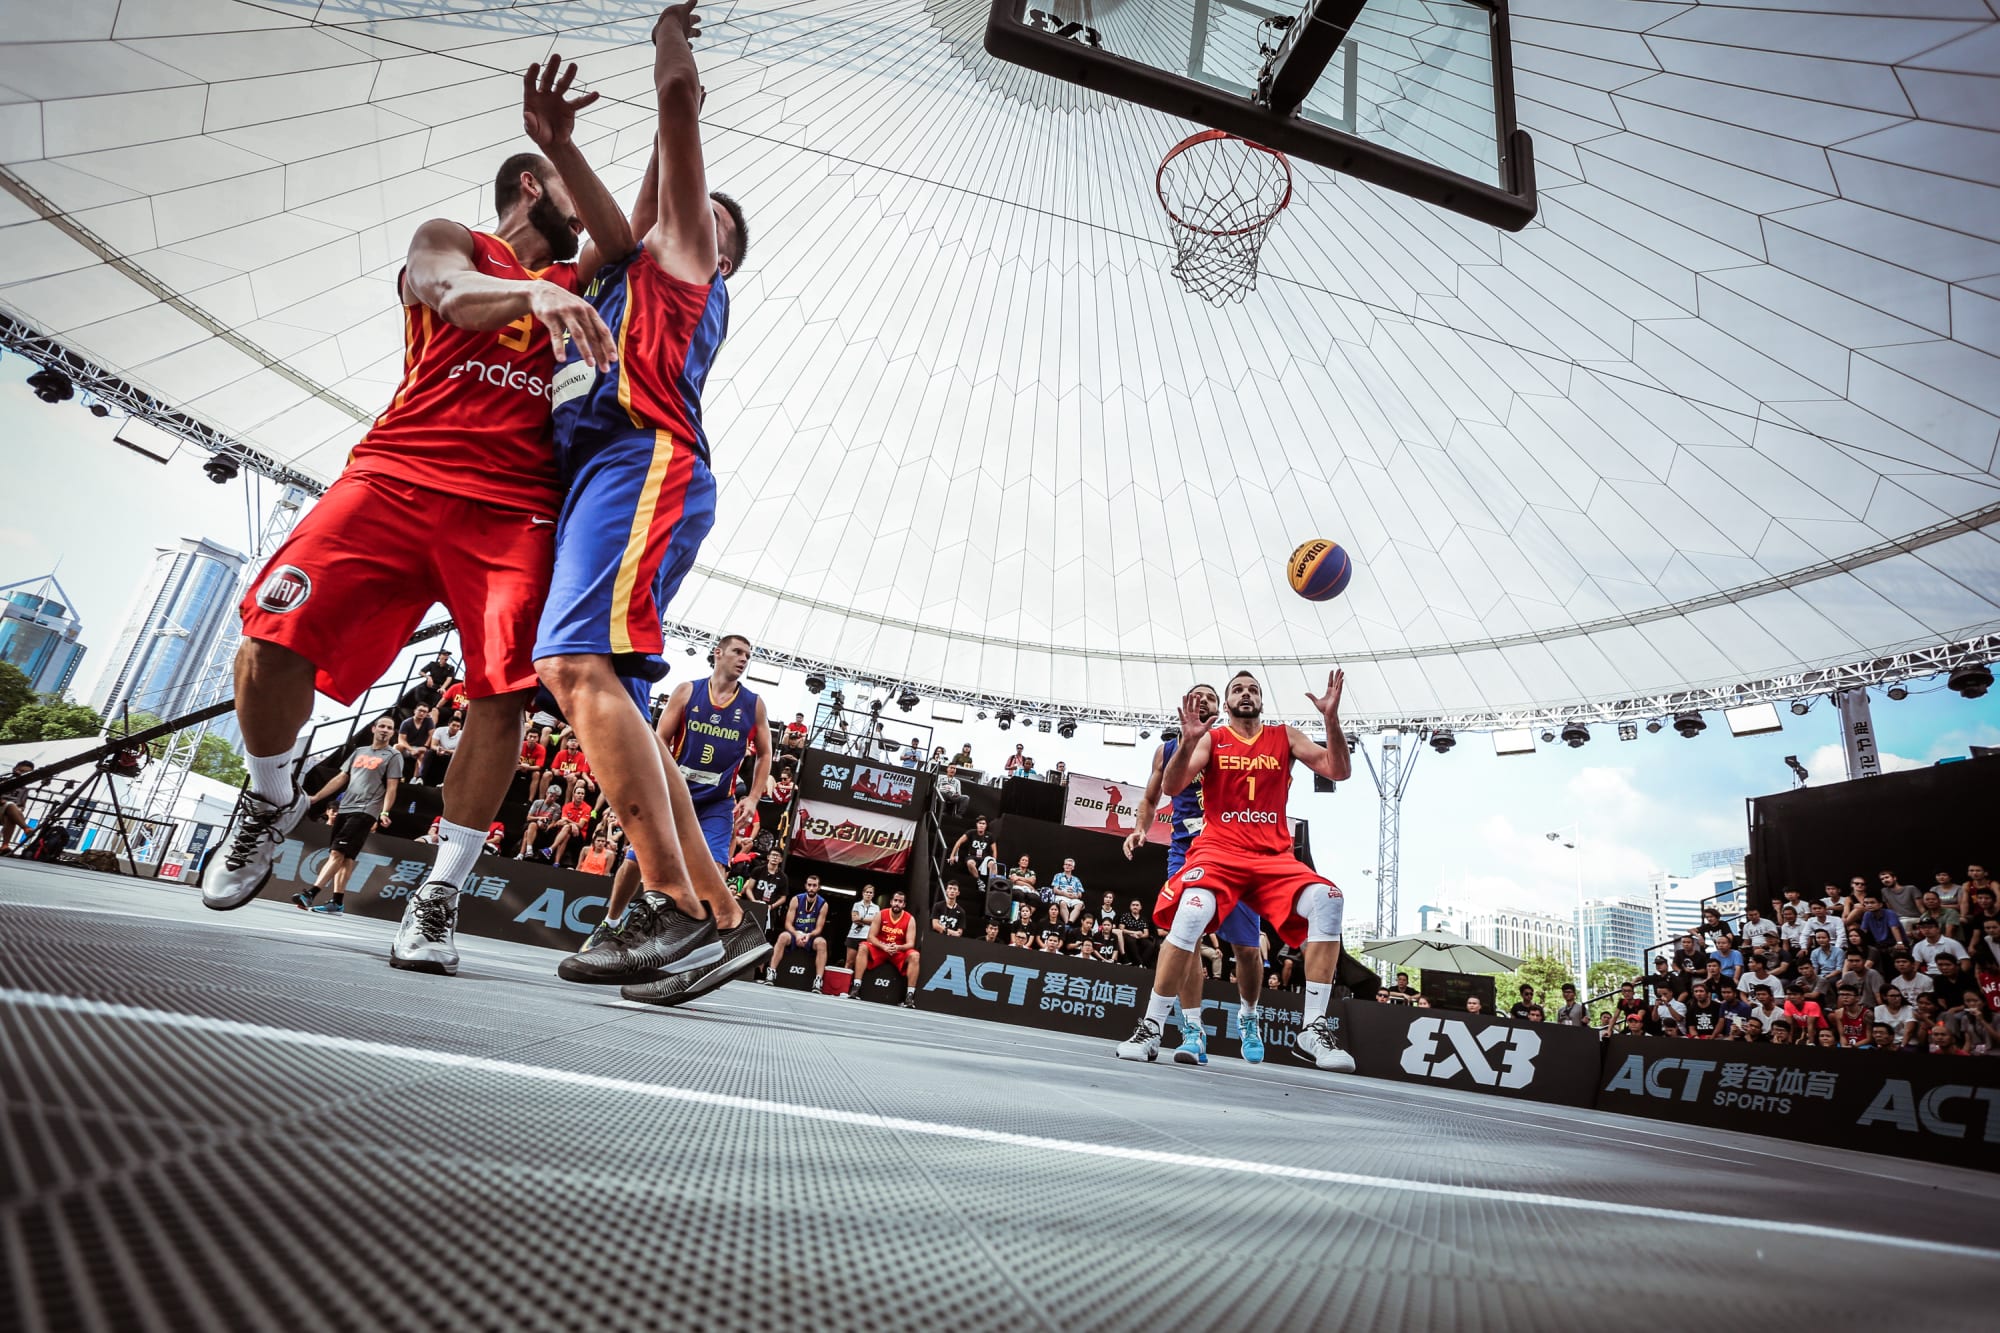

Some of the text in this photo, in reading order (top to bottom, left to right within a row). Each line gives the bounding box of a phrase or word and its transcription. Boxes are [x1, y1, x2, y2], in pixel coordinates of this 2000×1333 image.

[700, 743, 715, 764] 3
[1218, 754, 1281, 770] ESPAÑA
[823, 780, 842, 791] FIBA
[883, 771, 913, 784] CHINA
[1246, 776, 1256, 800] 1
[1074, 796, 1104, 810] 2016
[1105, 803, 1132, 817] FIBA
[1221, 808, 1278, 824] endesa
[379, 884, 416, 901] SPO
[513, 887, 630, 934] AC
[922, 955, 1040, 1006] ACT
[1042, 972, 1138, 1008] 爱奇体育
[1039, 996, 1106, 1019] SPORTS
[1259, 1022, 1297, 1048] lub
[1605, 1054, 1717, 1102] ACT
[1718, 1062, 1840, 1100] 爱奇体育
[1713, 1090, 1792, 1114] SPORTS
